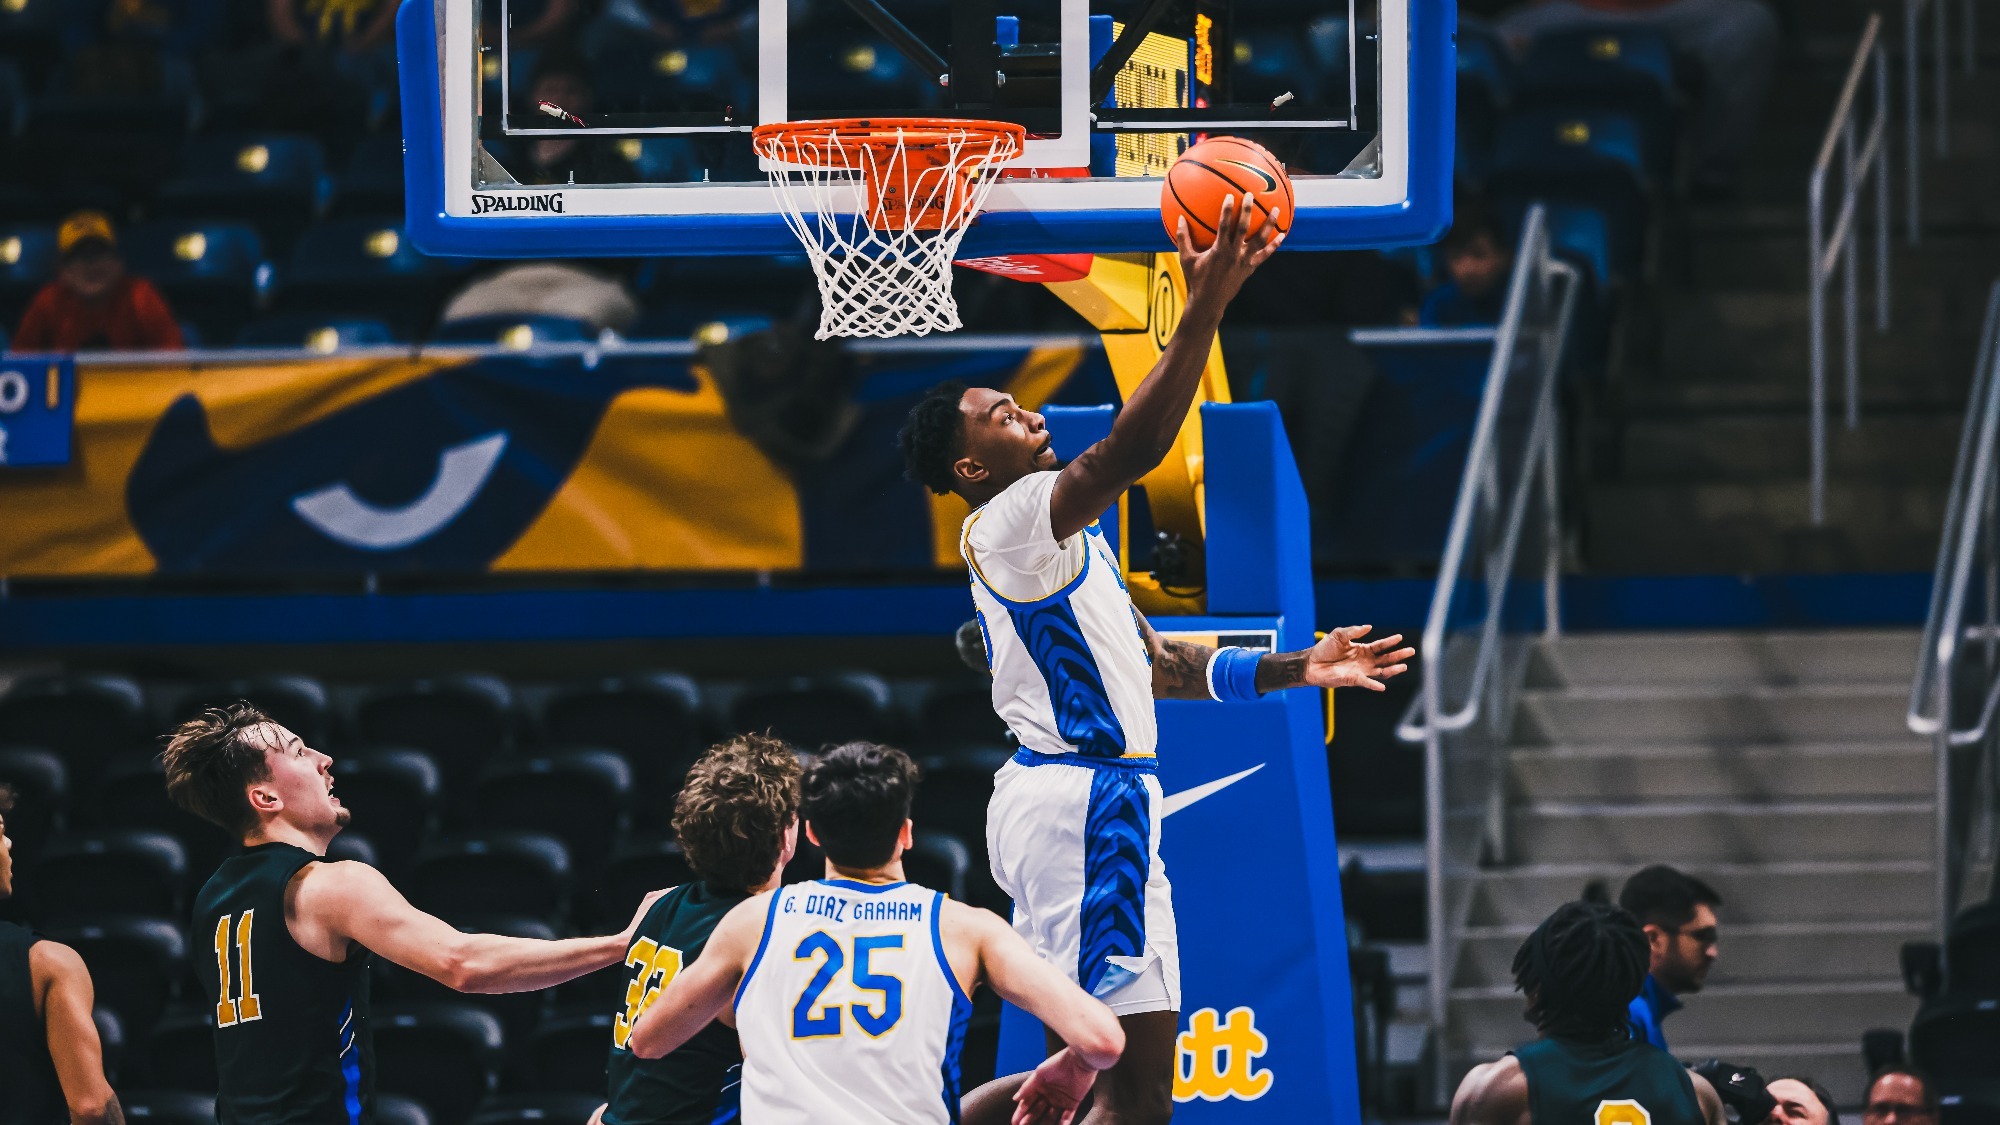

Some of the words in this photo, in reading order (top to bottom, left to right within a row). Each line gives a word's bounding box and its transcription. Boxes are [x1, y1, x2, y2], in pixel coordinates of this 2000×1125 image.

[471, 192, 563, 215] SPALDING
[784, 896, 797, 914] G.
[806, 895, 848, 923] DIAZ
[853, 901, 922, 922] GRAHAM
[214, 907, 263, 1029] 11
[791, 928, 907, 1040] 25
